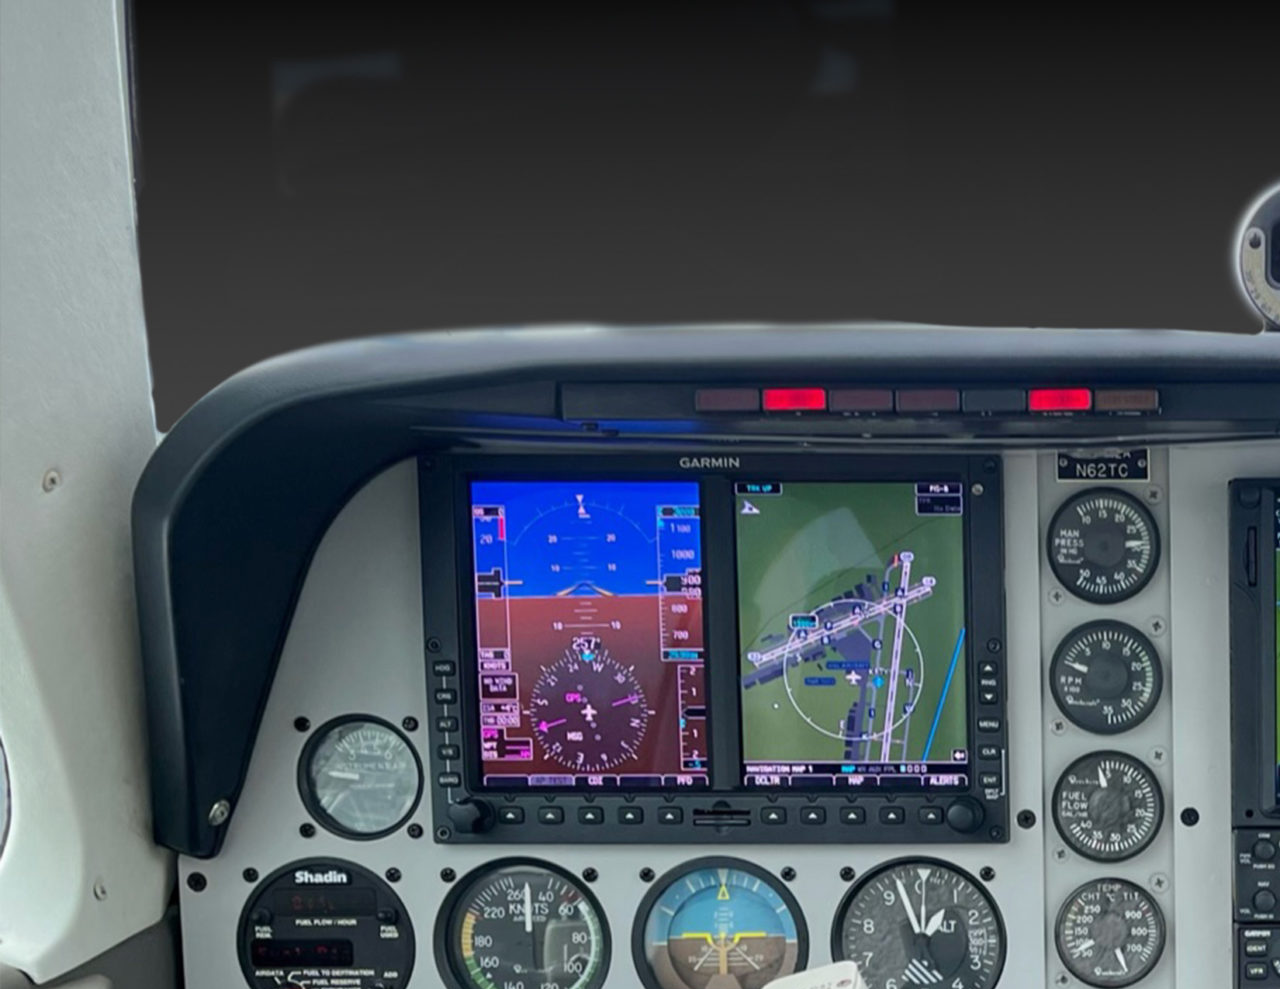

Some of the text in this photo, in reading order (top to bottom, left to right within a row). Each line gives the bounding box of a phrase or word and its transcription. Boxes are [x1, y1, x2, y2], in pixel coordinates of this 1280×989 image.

[679, 457, 740, 468] GARMIN
[1076, 464, 1129, 478] N62TC
[1060, 530, 1080, 538] MAN
[1055, 539, 1084, 548] PRESS
[1060, 676, 1082, 686] RPM
[930, 777, 959, 786] ALERTS
[1062, 792, 1087, 800] FUEL
[1062, 802, 1088, 810] FLOW
[294, 870, 348, 884] Shadin
[538, 891, 554, 902] 40
[884, 890, 895, 906] 9
[484, 906, 505, 918] 220
[558, 904, 574, 915] 60
[968, 910, 980, 925] 2
[863, 918, 874, 934] 8
[474, 936, 493, 947] 180
[572, 932, 588, 944] 80
[480, 956, 500, 968] 160
[862, 952, 874, 966] 7
[970, 954, 982, 970] 3
[564, 962, 583, 974] 100
